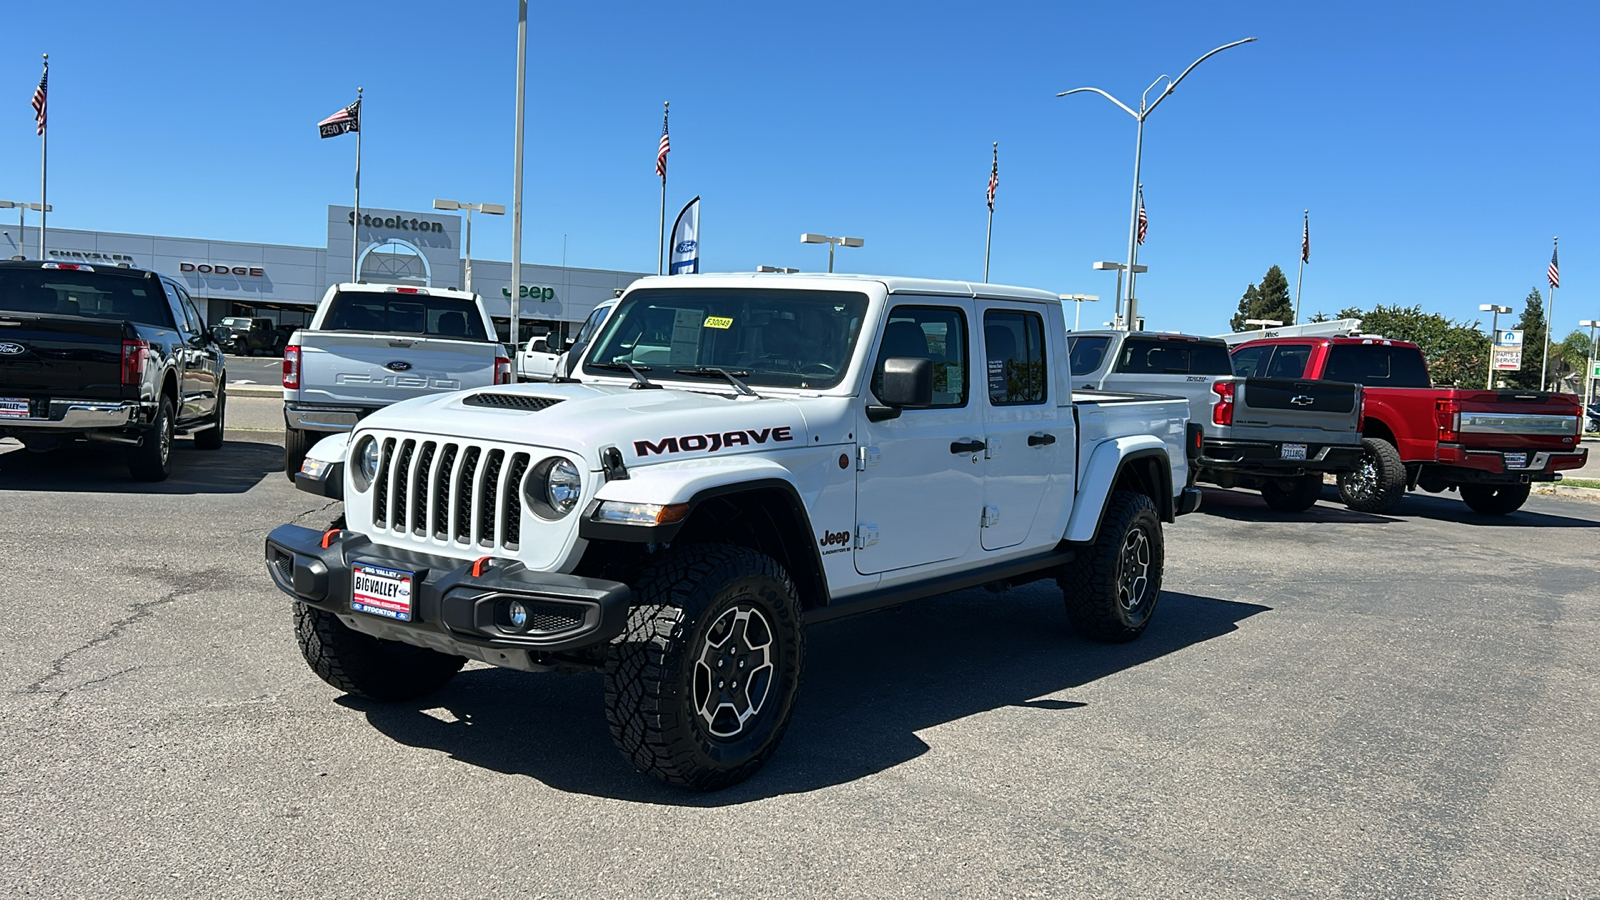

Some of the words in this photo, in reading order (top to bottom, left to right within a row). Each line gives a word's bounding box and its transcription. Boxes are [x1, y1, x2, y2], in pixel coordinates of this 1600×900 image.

[321, 124, 339, 136] 250
[348, 211, 443, 233] Stockton
[49, 250, 132, 261] CHRYSLER
[180, 262, 264, 277] DODGE
[706, 318, 730, 327] F30049
[391, 362, 408, 370] Ford
[335, 373, 461, 390] F-150
[633, 426, 793, 457] MOJAVE
[820, 530, 850, 546] Jeep
[376, 568, 397, 577] VALLEY
[356, 576, 399, 597] BIGVALLEY
[363, 605, 397, 617] STOCKTON
